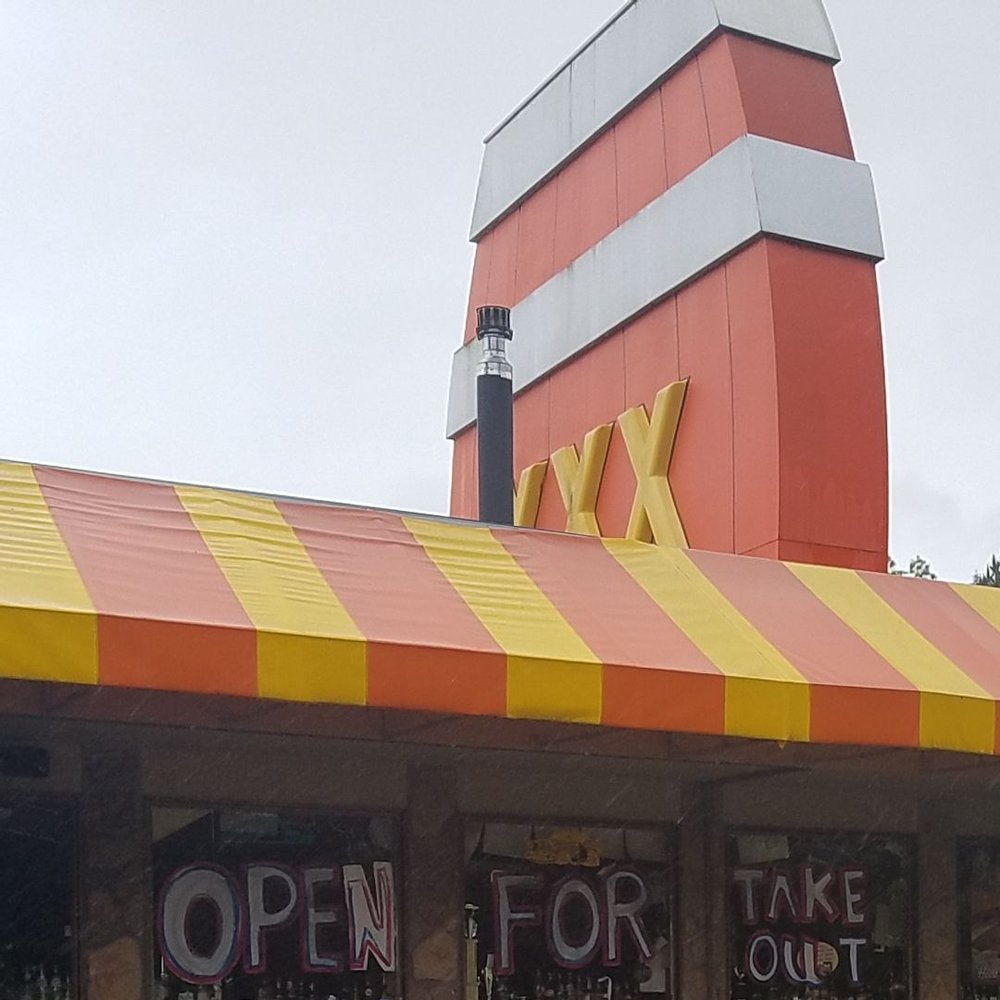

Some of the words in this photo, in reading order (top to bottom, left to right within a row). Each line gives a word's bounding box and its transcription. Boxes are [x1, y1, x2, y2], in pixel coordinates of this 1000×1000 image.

[513, 376, 690, 549] XX
[161, 861, 396, 983] OPEN
[491, 866, 652, 974] FOR
[734, 867, 865, 924] TAKE
[747, 932, 867, 985] OUT
